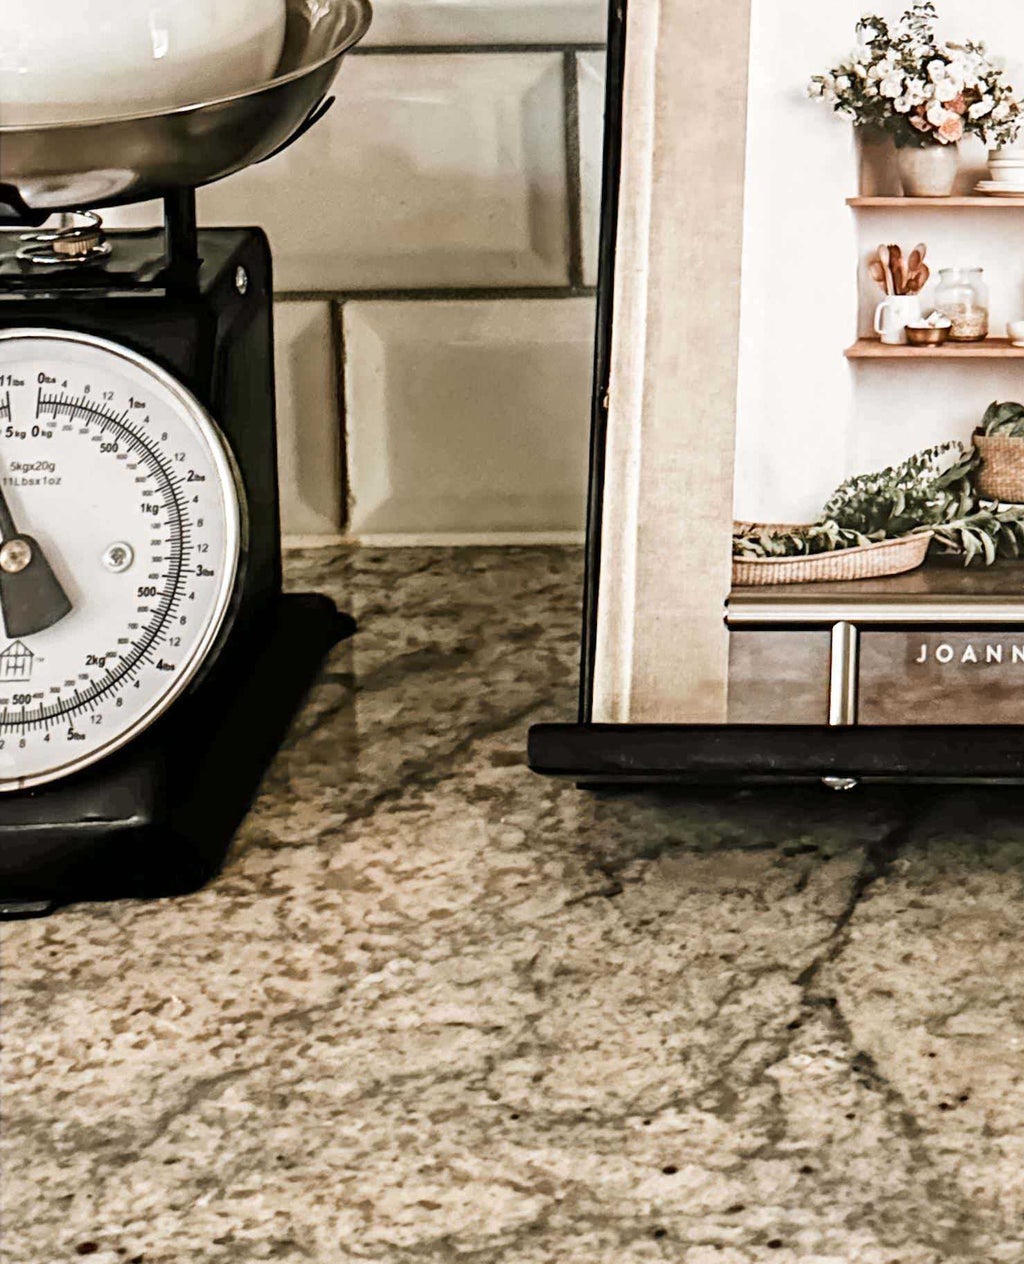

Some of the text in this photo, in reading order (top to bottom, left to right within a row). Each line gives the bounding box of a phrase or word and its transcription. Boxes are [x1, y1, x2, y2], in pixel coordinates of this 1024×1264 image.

[61, 380, 68, 388] 4
[103, 392, 114, 400] 12
[100, 443, 119, 453] 500
[174, 453, 186, 462] 12
[192, 495, 199, 503] 4
[140, 503, 159, 515] 1kg
[197, 544, 209, 552] 12
[137, 587, 156, 597] 500
[188, 592, 195, 600] 4
[169, 637, 181, 646] 12
[85, 655, 106, 668] 2kg
[133, 680, 140, 688] 4
[12, 694, 31, 705] 500
[90, 715, 102, 724] 12
[44, 734, 50, 742] 4
